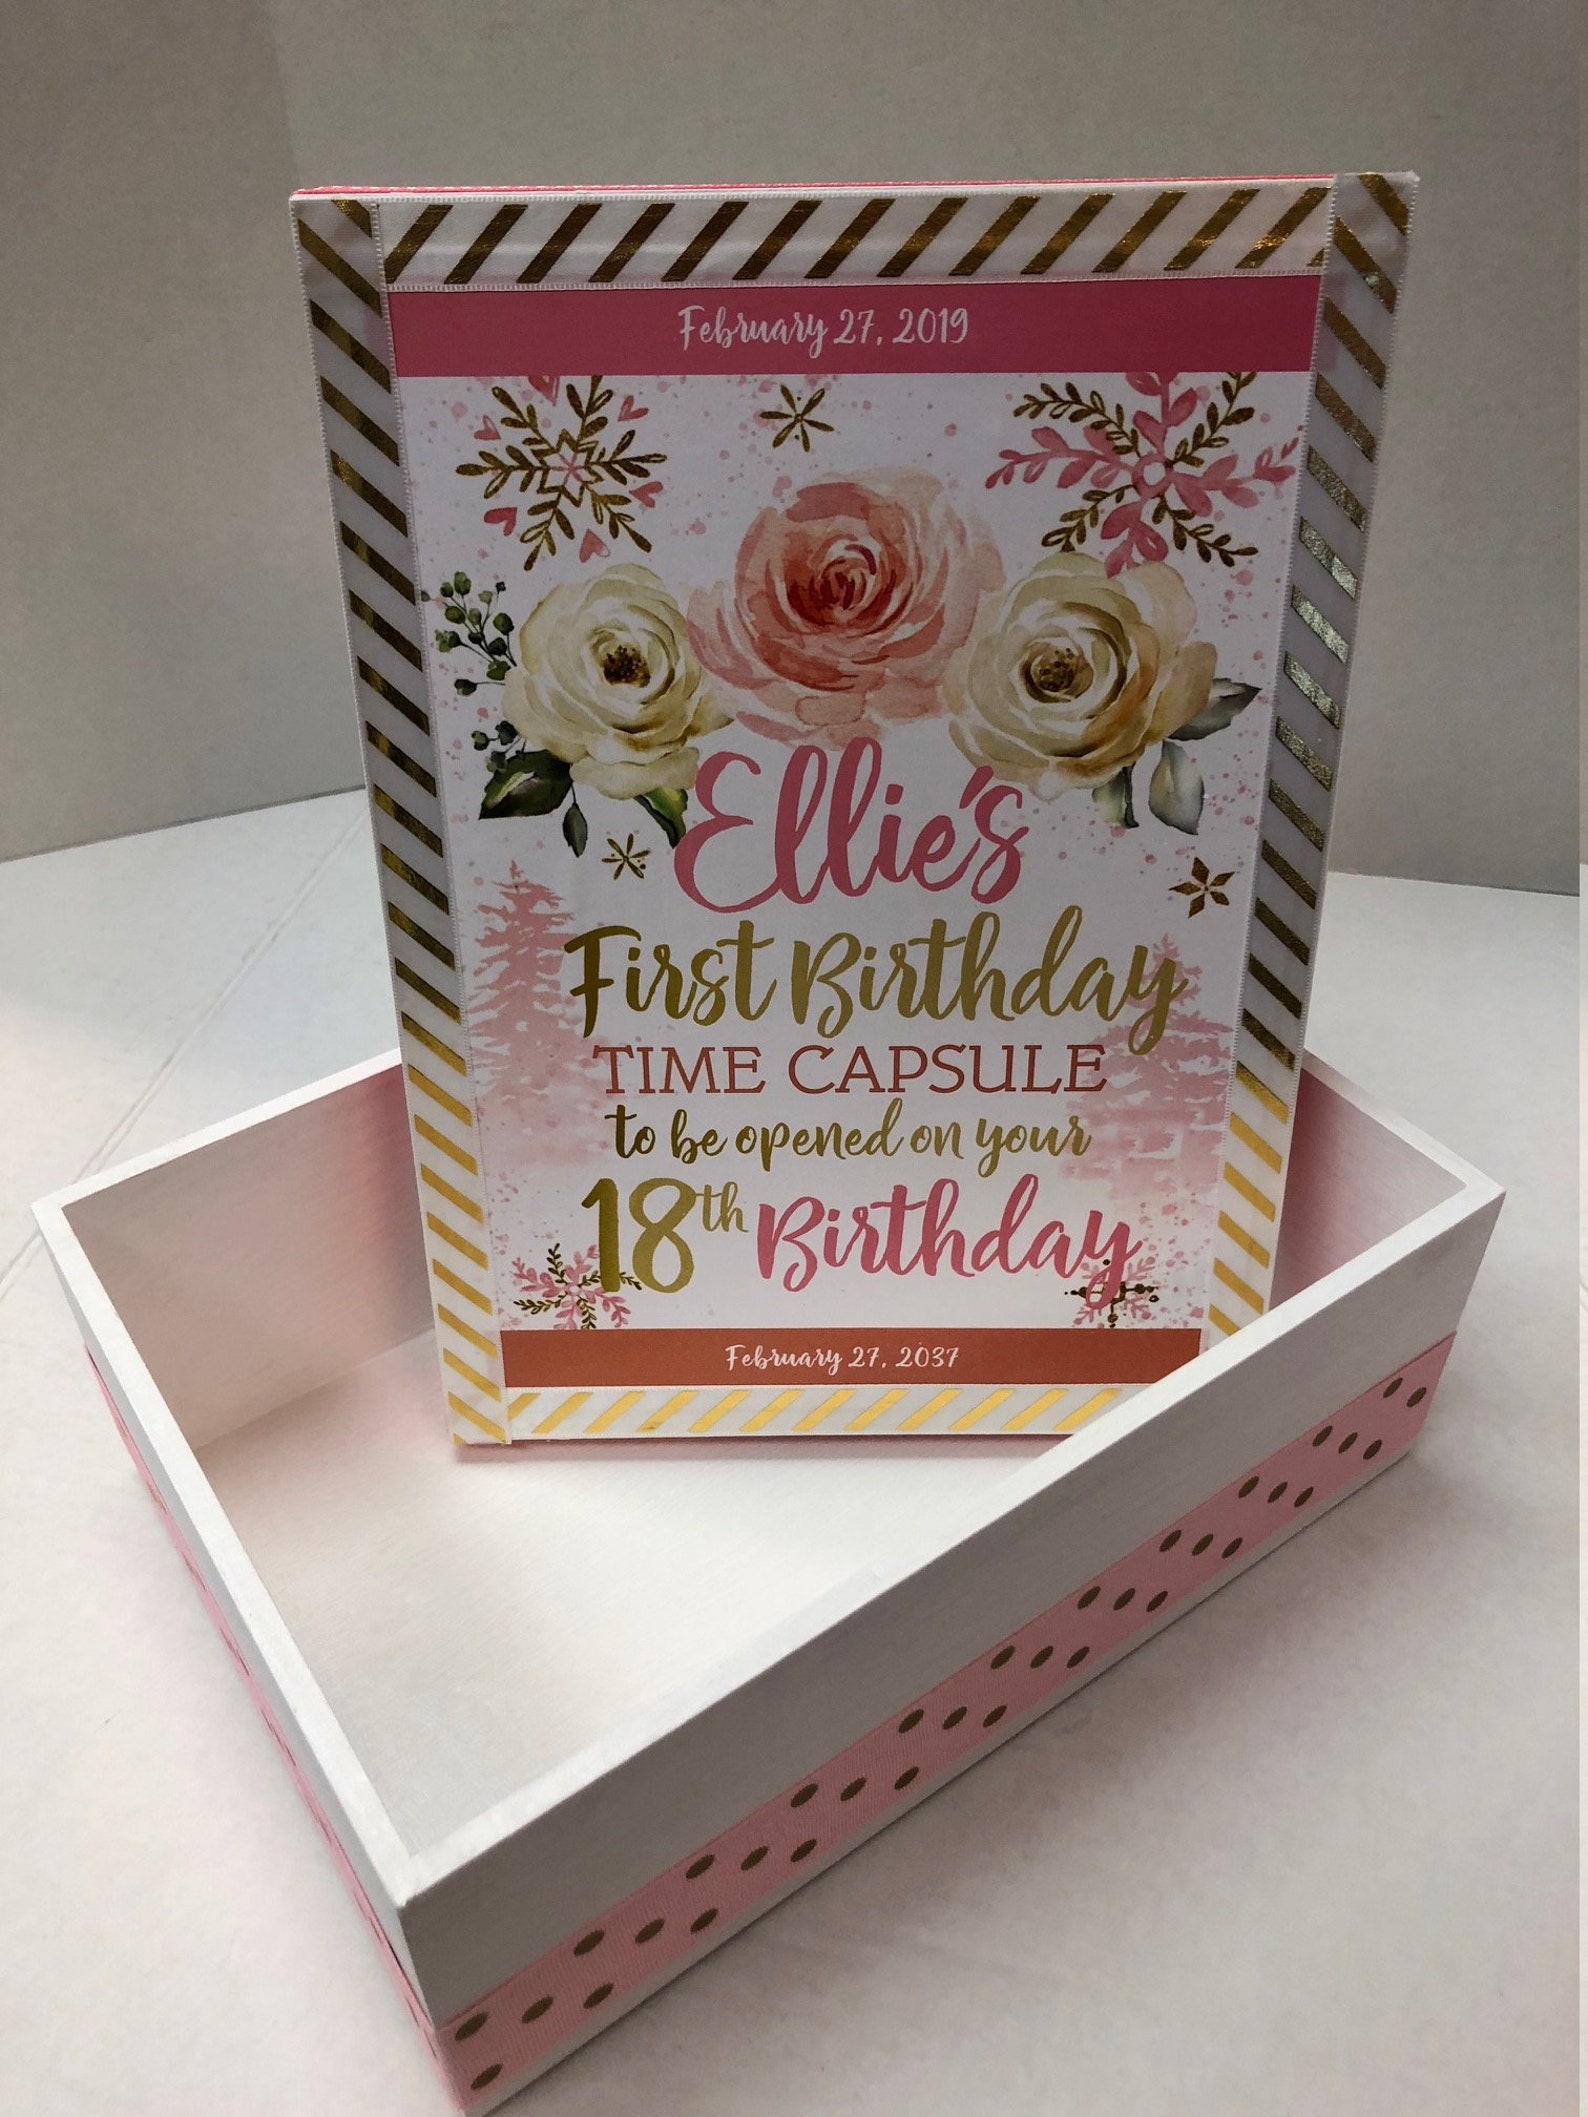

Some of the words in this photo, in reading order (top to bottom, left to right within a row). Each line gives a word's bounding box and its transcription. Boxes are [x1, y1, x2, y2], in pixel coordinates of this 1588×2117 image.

[678, 305, 828, 359] February
[833, 308, 882, 346] 27,
[892, 307, 969, 344] 2019
[674, 736, 1029, 914] Ellie's
[563, 920, 777, 1038] First
[791, 904, 1188, 1056] Birthday
[592, 1044, 766, 1095] TIME
[787, 1043, 1108, 1094] CAPSULE
[604, 1104, 656, 1156] to
[670, 1108, 728, 1159] be
[735, 1097, 903, 1172] opened
[909, 1131, 963, 1160] on
[975, 1114, 1093, 1178] your
[580, 1176, 748, 1294] 18th
[755, 1172, 1143, 1310] Birthday
[725, 1344, 843, 1376] February
[895, 1346, 960, 1368] 2037
